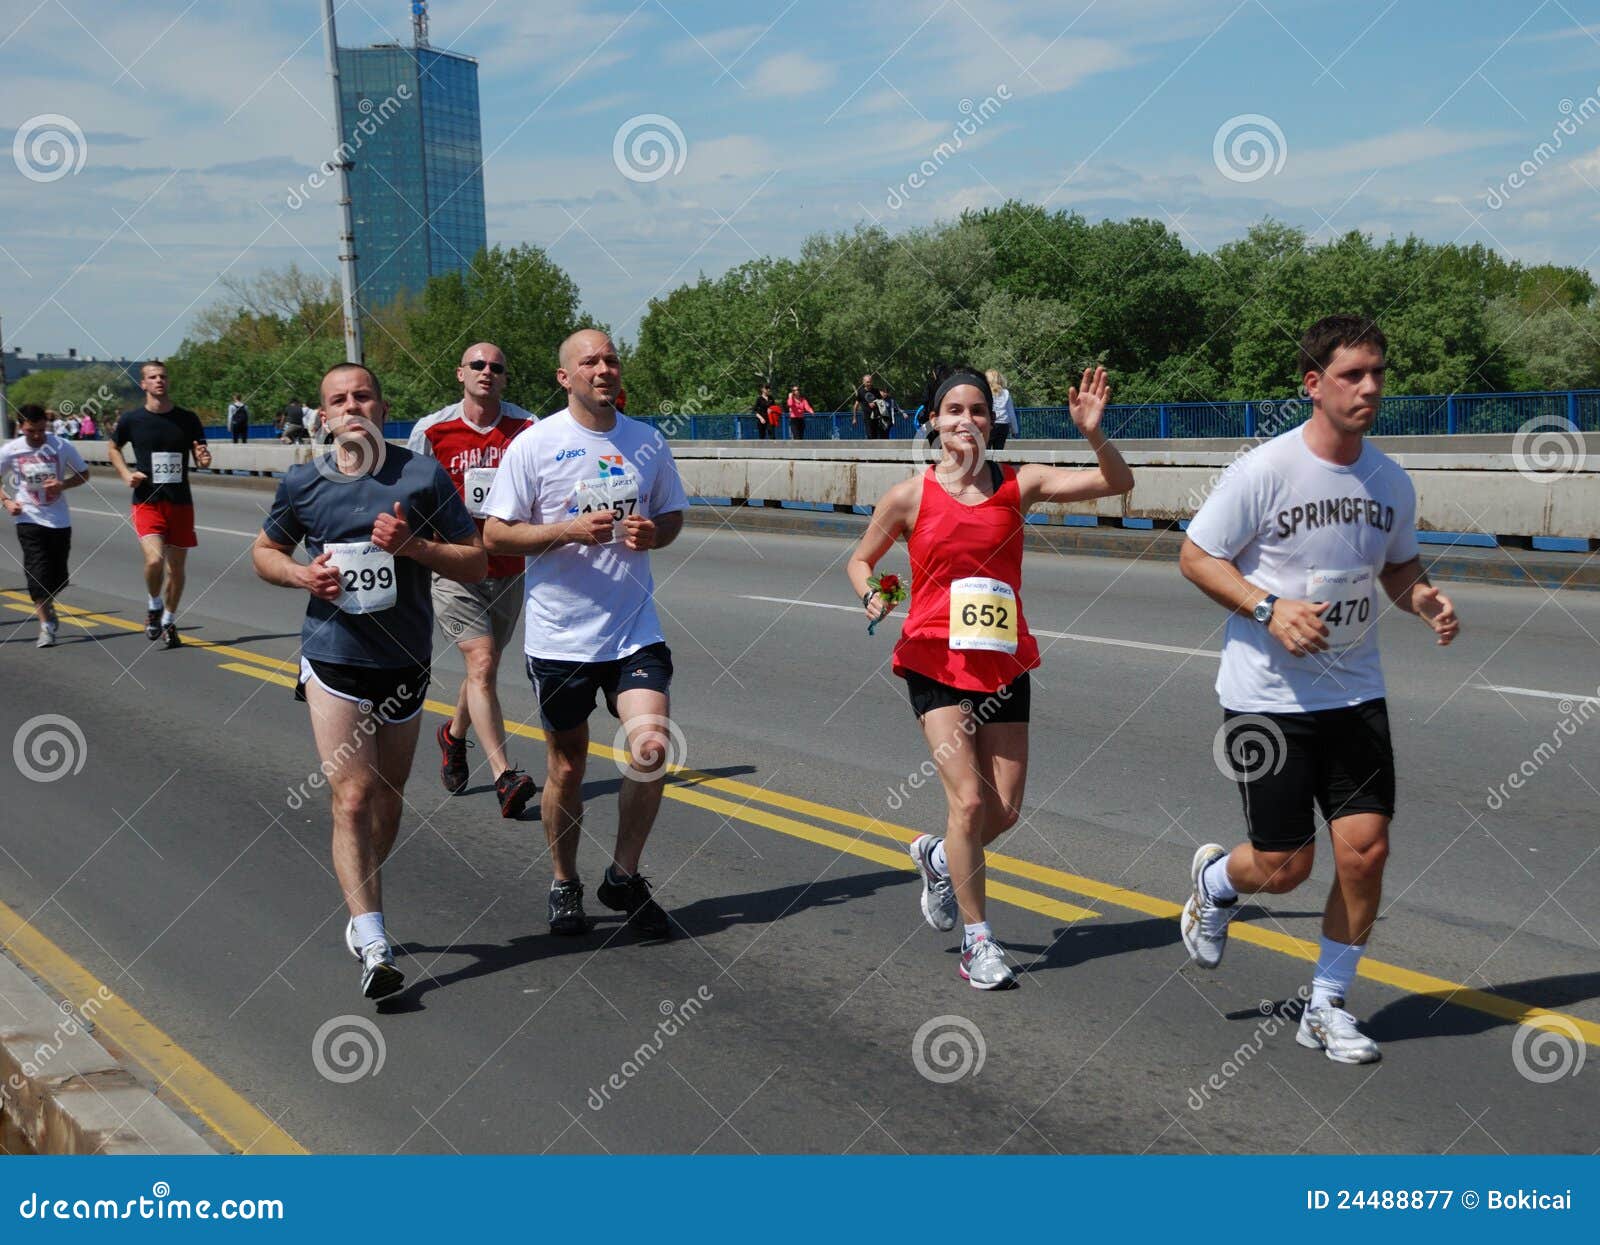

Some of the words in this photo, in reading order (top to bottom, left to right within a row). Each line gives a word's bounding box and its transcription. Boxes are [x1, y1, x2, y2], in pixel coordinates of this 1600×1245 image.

[450, 446, 506, 474] CHAMPI
[566, 448, 586, 458] asics
[154, 463, 181, 474] 2323
[473, 486, 491, 503] 9
[1277, 497, 1395, 538] SPRINGFIELD
[962, 604, 1009, 629] 652
[1312, 597, 1370, 627] 470
